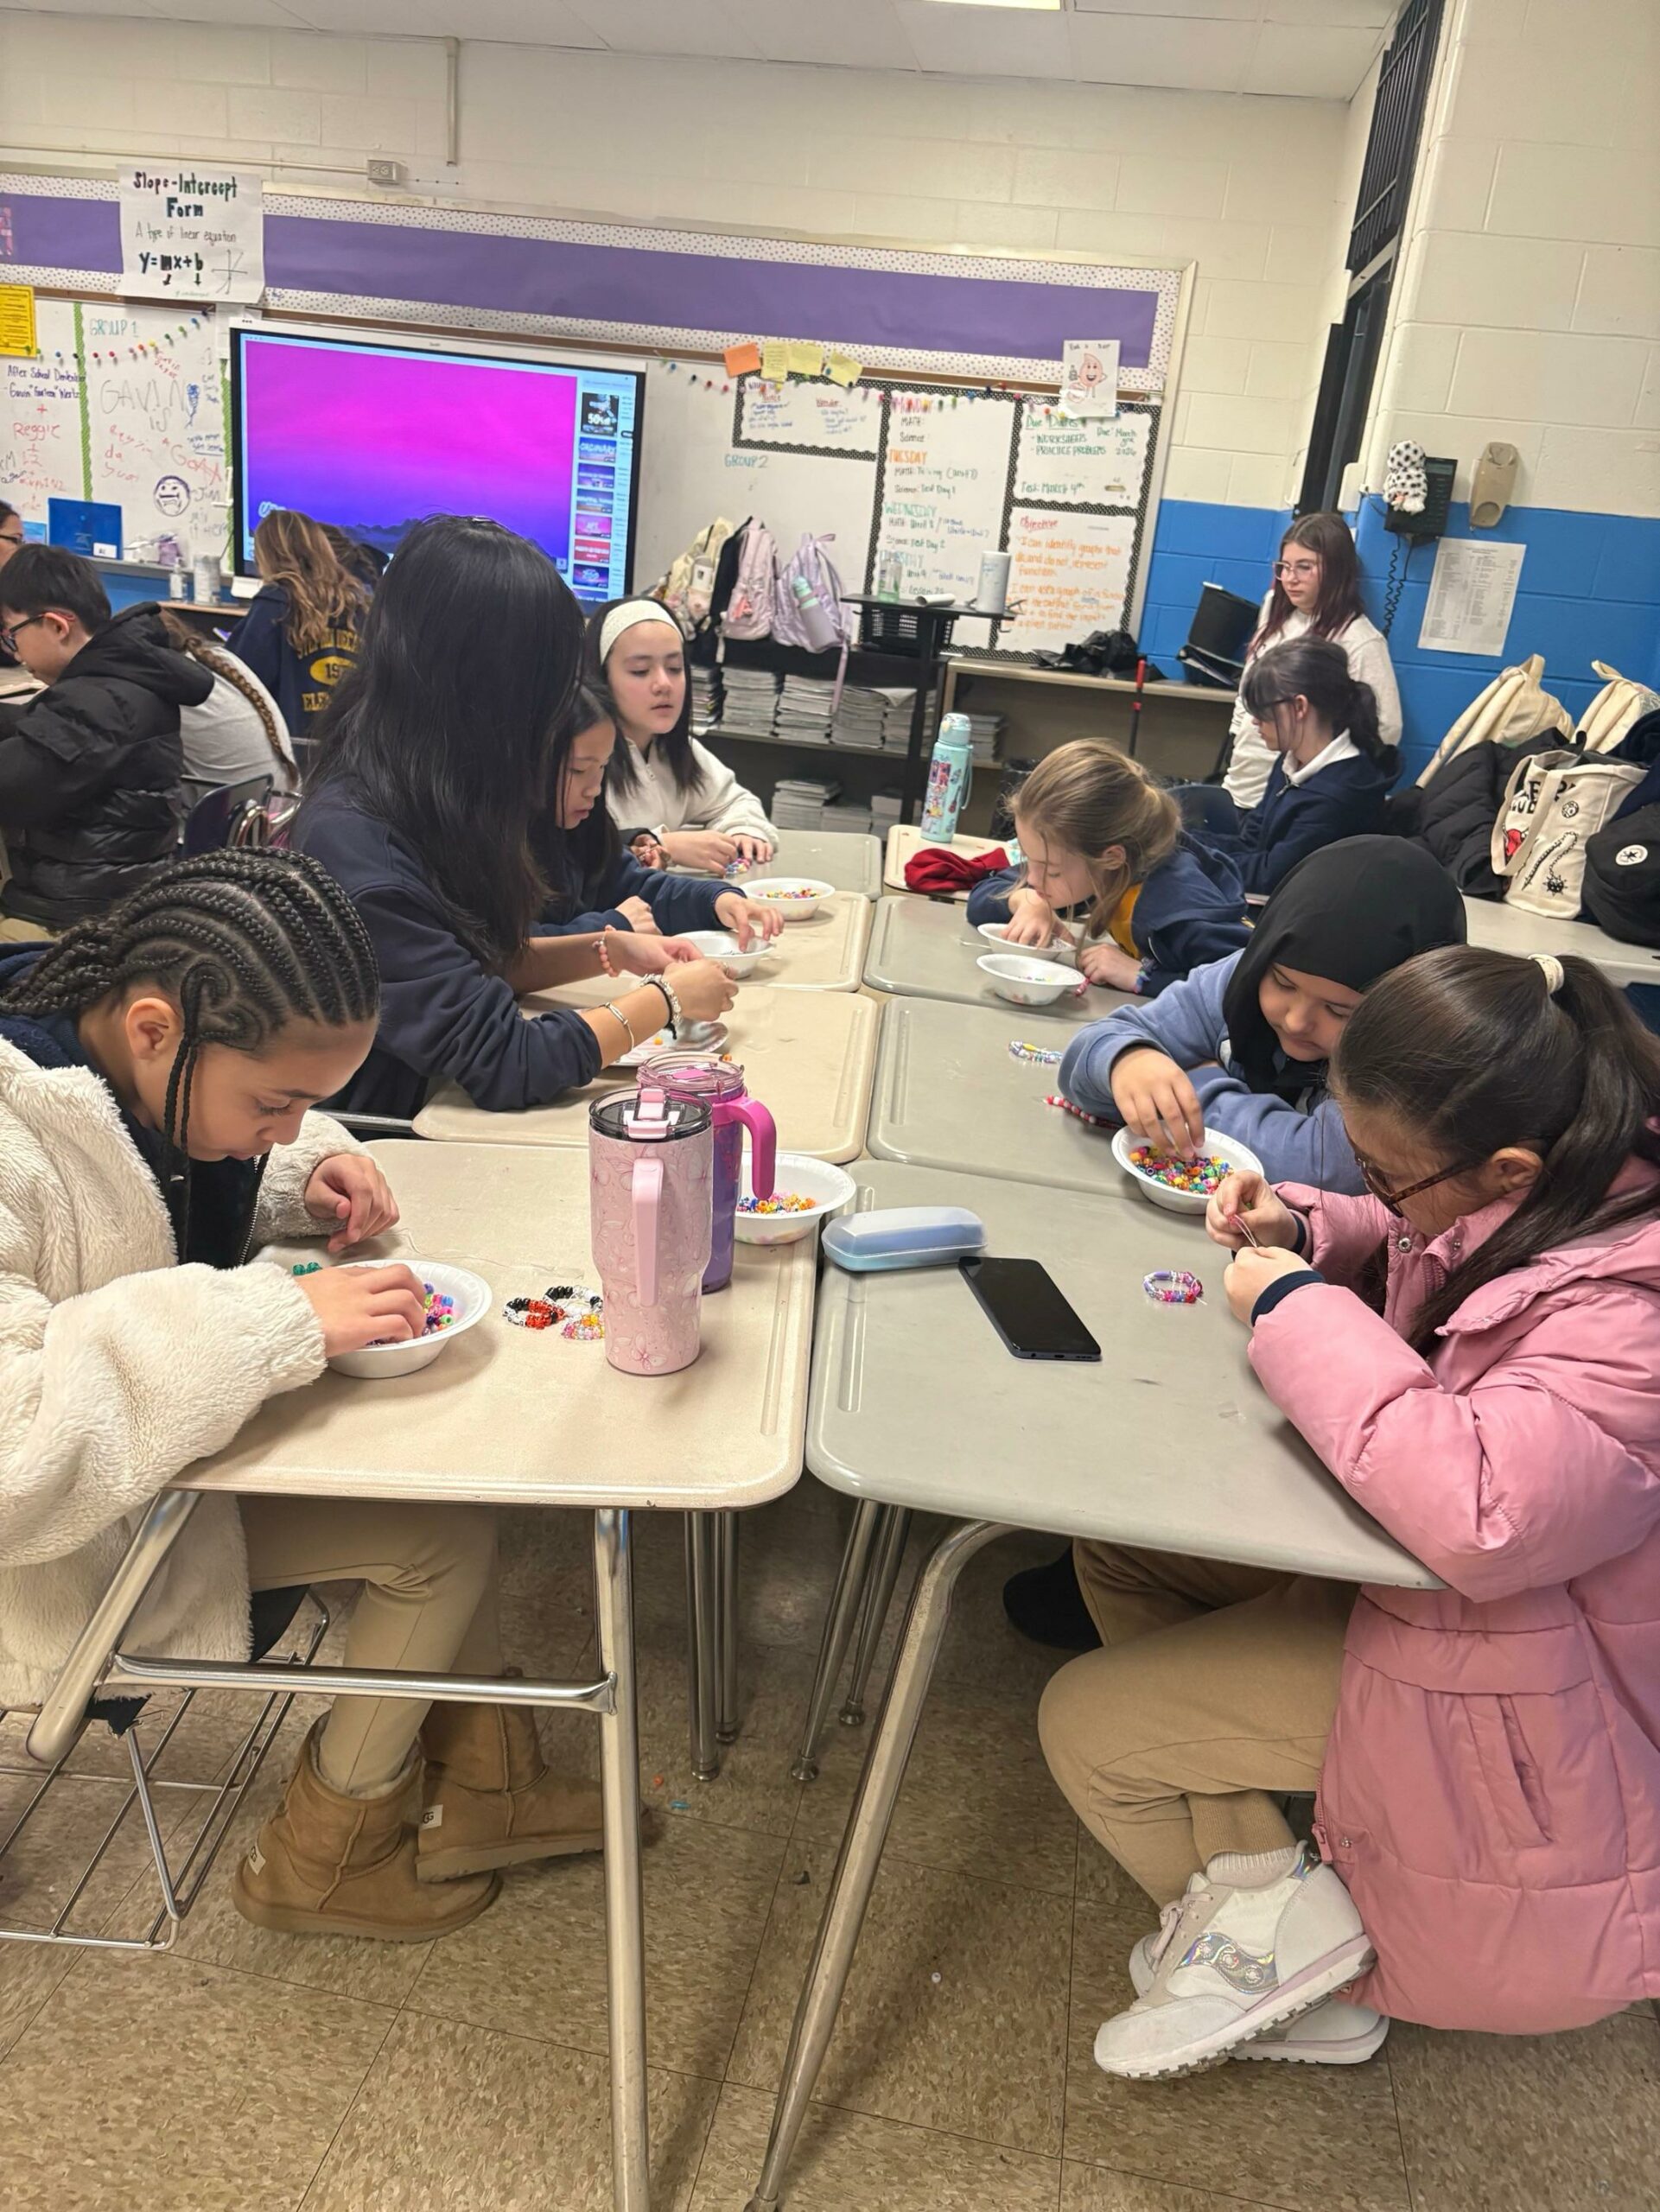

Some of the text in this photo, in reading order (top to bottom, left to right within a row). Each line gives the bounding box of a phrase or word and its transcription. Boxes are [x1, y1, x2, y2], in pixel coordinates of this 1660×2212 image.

[133, 172, 238, 201] Slope-Intercept
[166, 197, 204, 218] Form
[135, 222, 237, 246] A type of linear equation
[889, 448, 928, 464] TUESDAY
